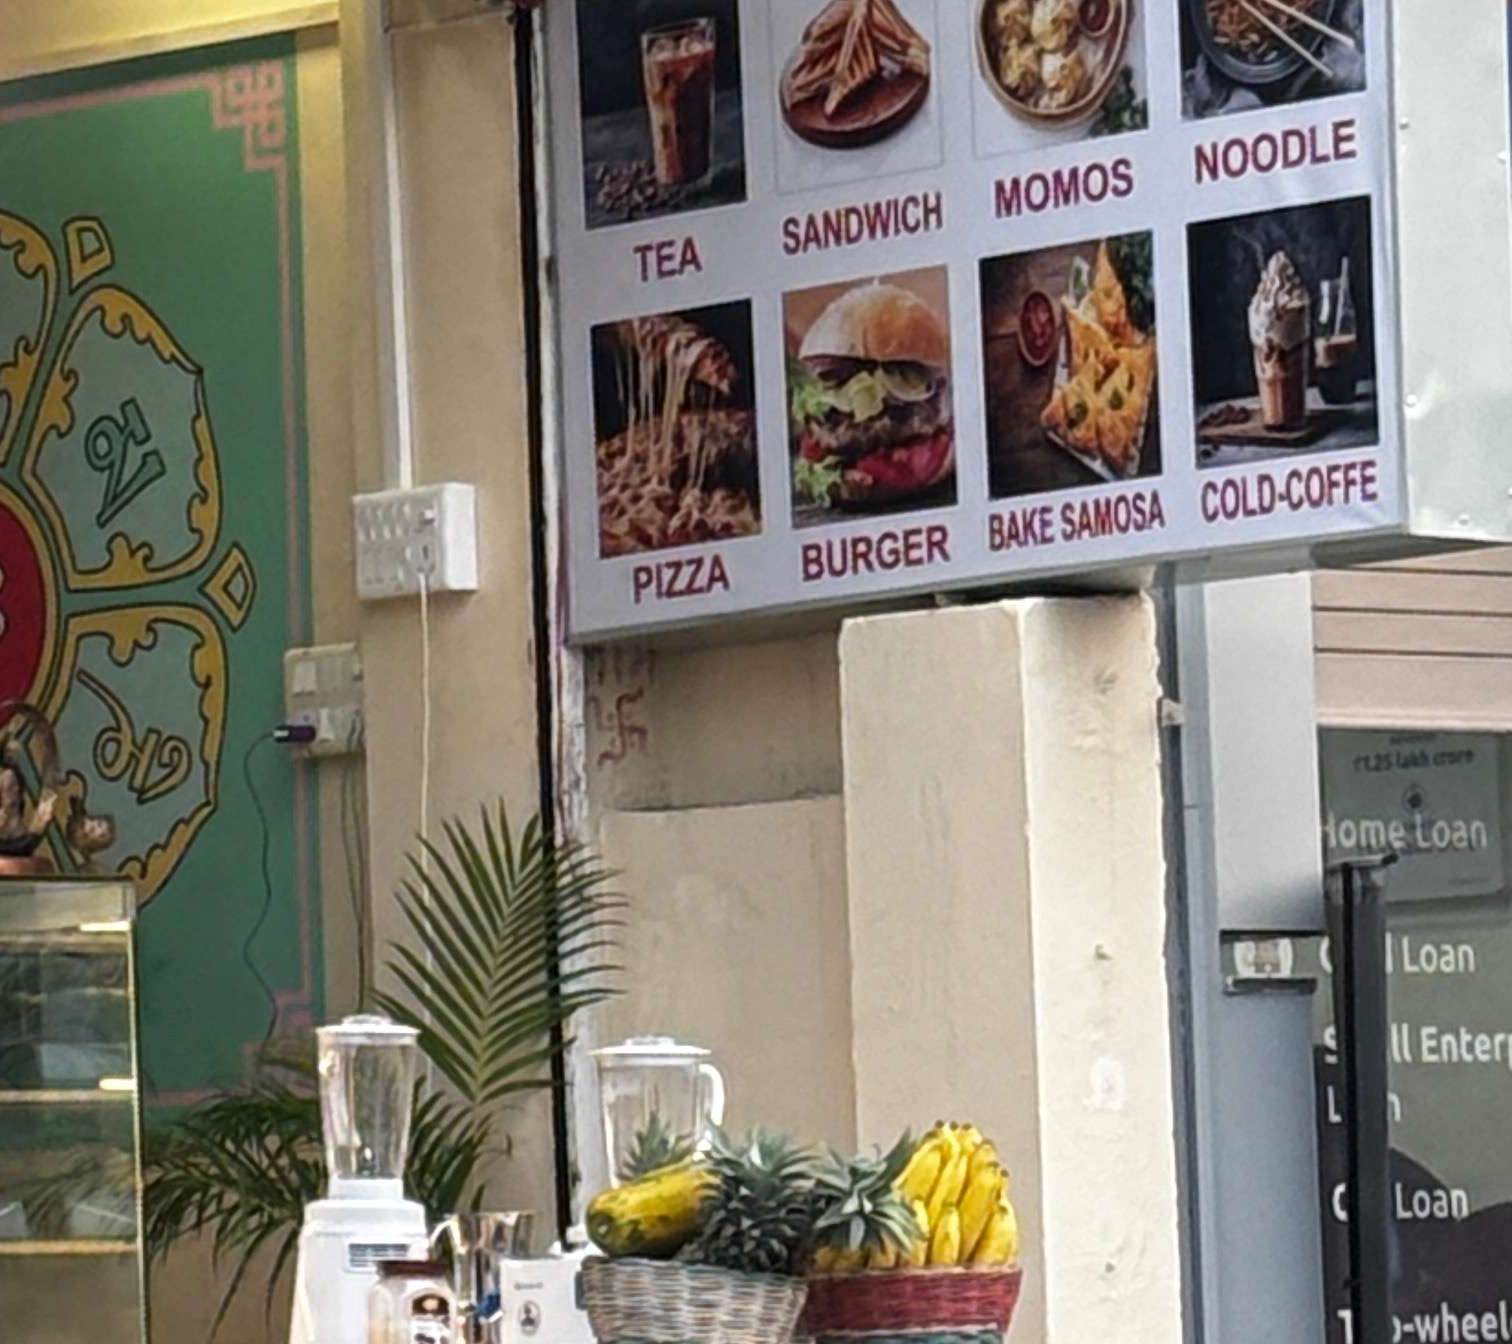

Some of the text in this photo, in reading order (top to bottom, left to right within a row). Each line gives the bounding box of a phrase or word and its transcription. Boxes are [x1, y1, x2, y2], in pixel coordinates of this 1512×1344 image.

[1193, 118, 1359, 185] NOODLE
[993, 158, 1135, 219] MOMOS
[781, 191, 945, 256] SANDWICH
[634, 236, 702, 283] TEA
[1200, 459, 1380, 524] COLD-COFFE
[988, 490, 1165, 554] BAKE SAMOSA
[631, 552, 730, 604] PIZZA
[801, 523, 950, 583] BURGER
[1414, 812, 1488, 850] Loan
[1401, 935, 1476, 975] Loan
[1324, 1022, 1512, 1071] Sll Enter
[1394, 1181, 1469, 1221] Loan
